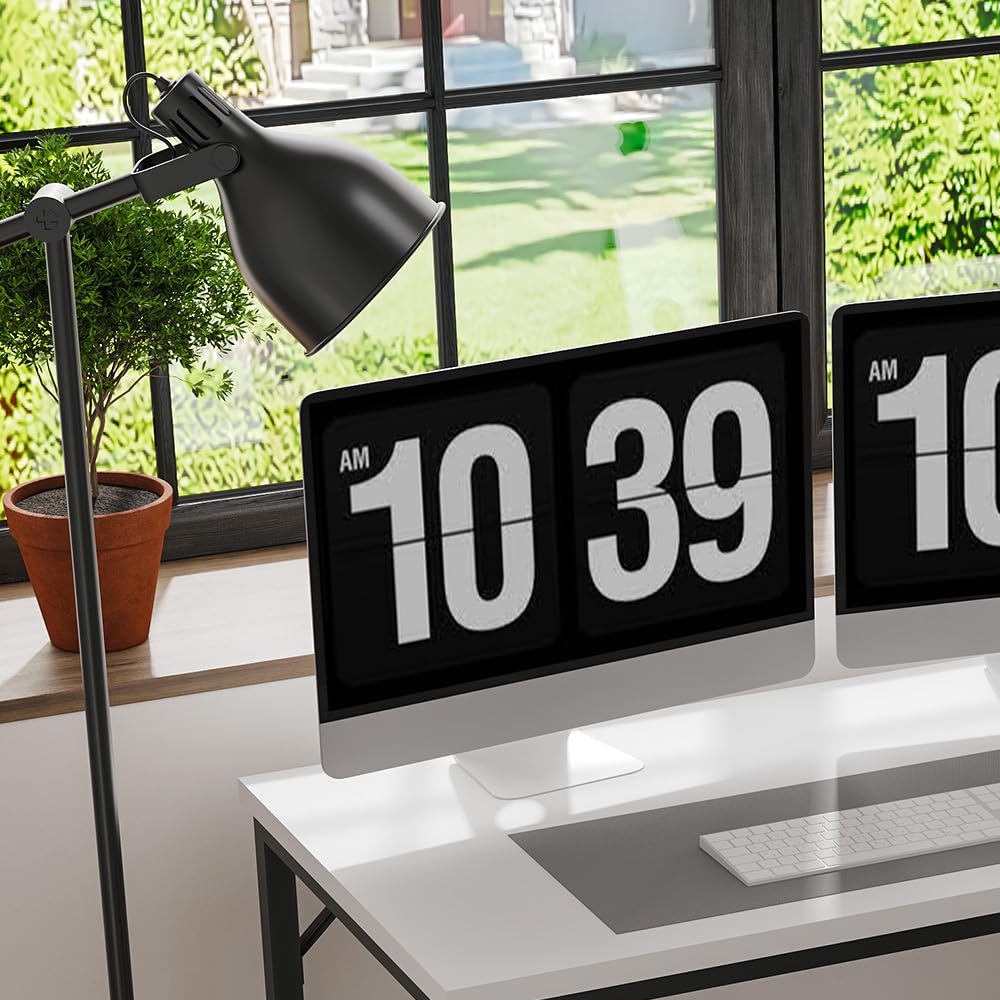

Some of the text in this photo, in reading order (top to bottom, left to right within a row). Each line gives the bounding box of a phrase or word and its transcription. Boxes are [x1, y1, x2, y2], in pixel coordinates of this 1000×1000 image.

[868, 359, 898, 383] AM
[339, 445, 371, 473] AM
[348, 380, 774, 646] 10 39
